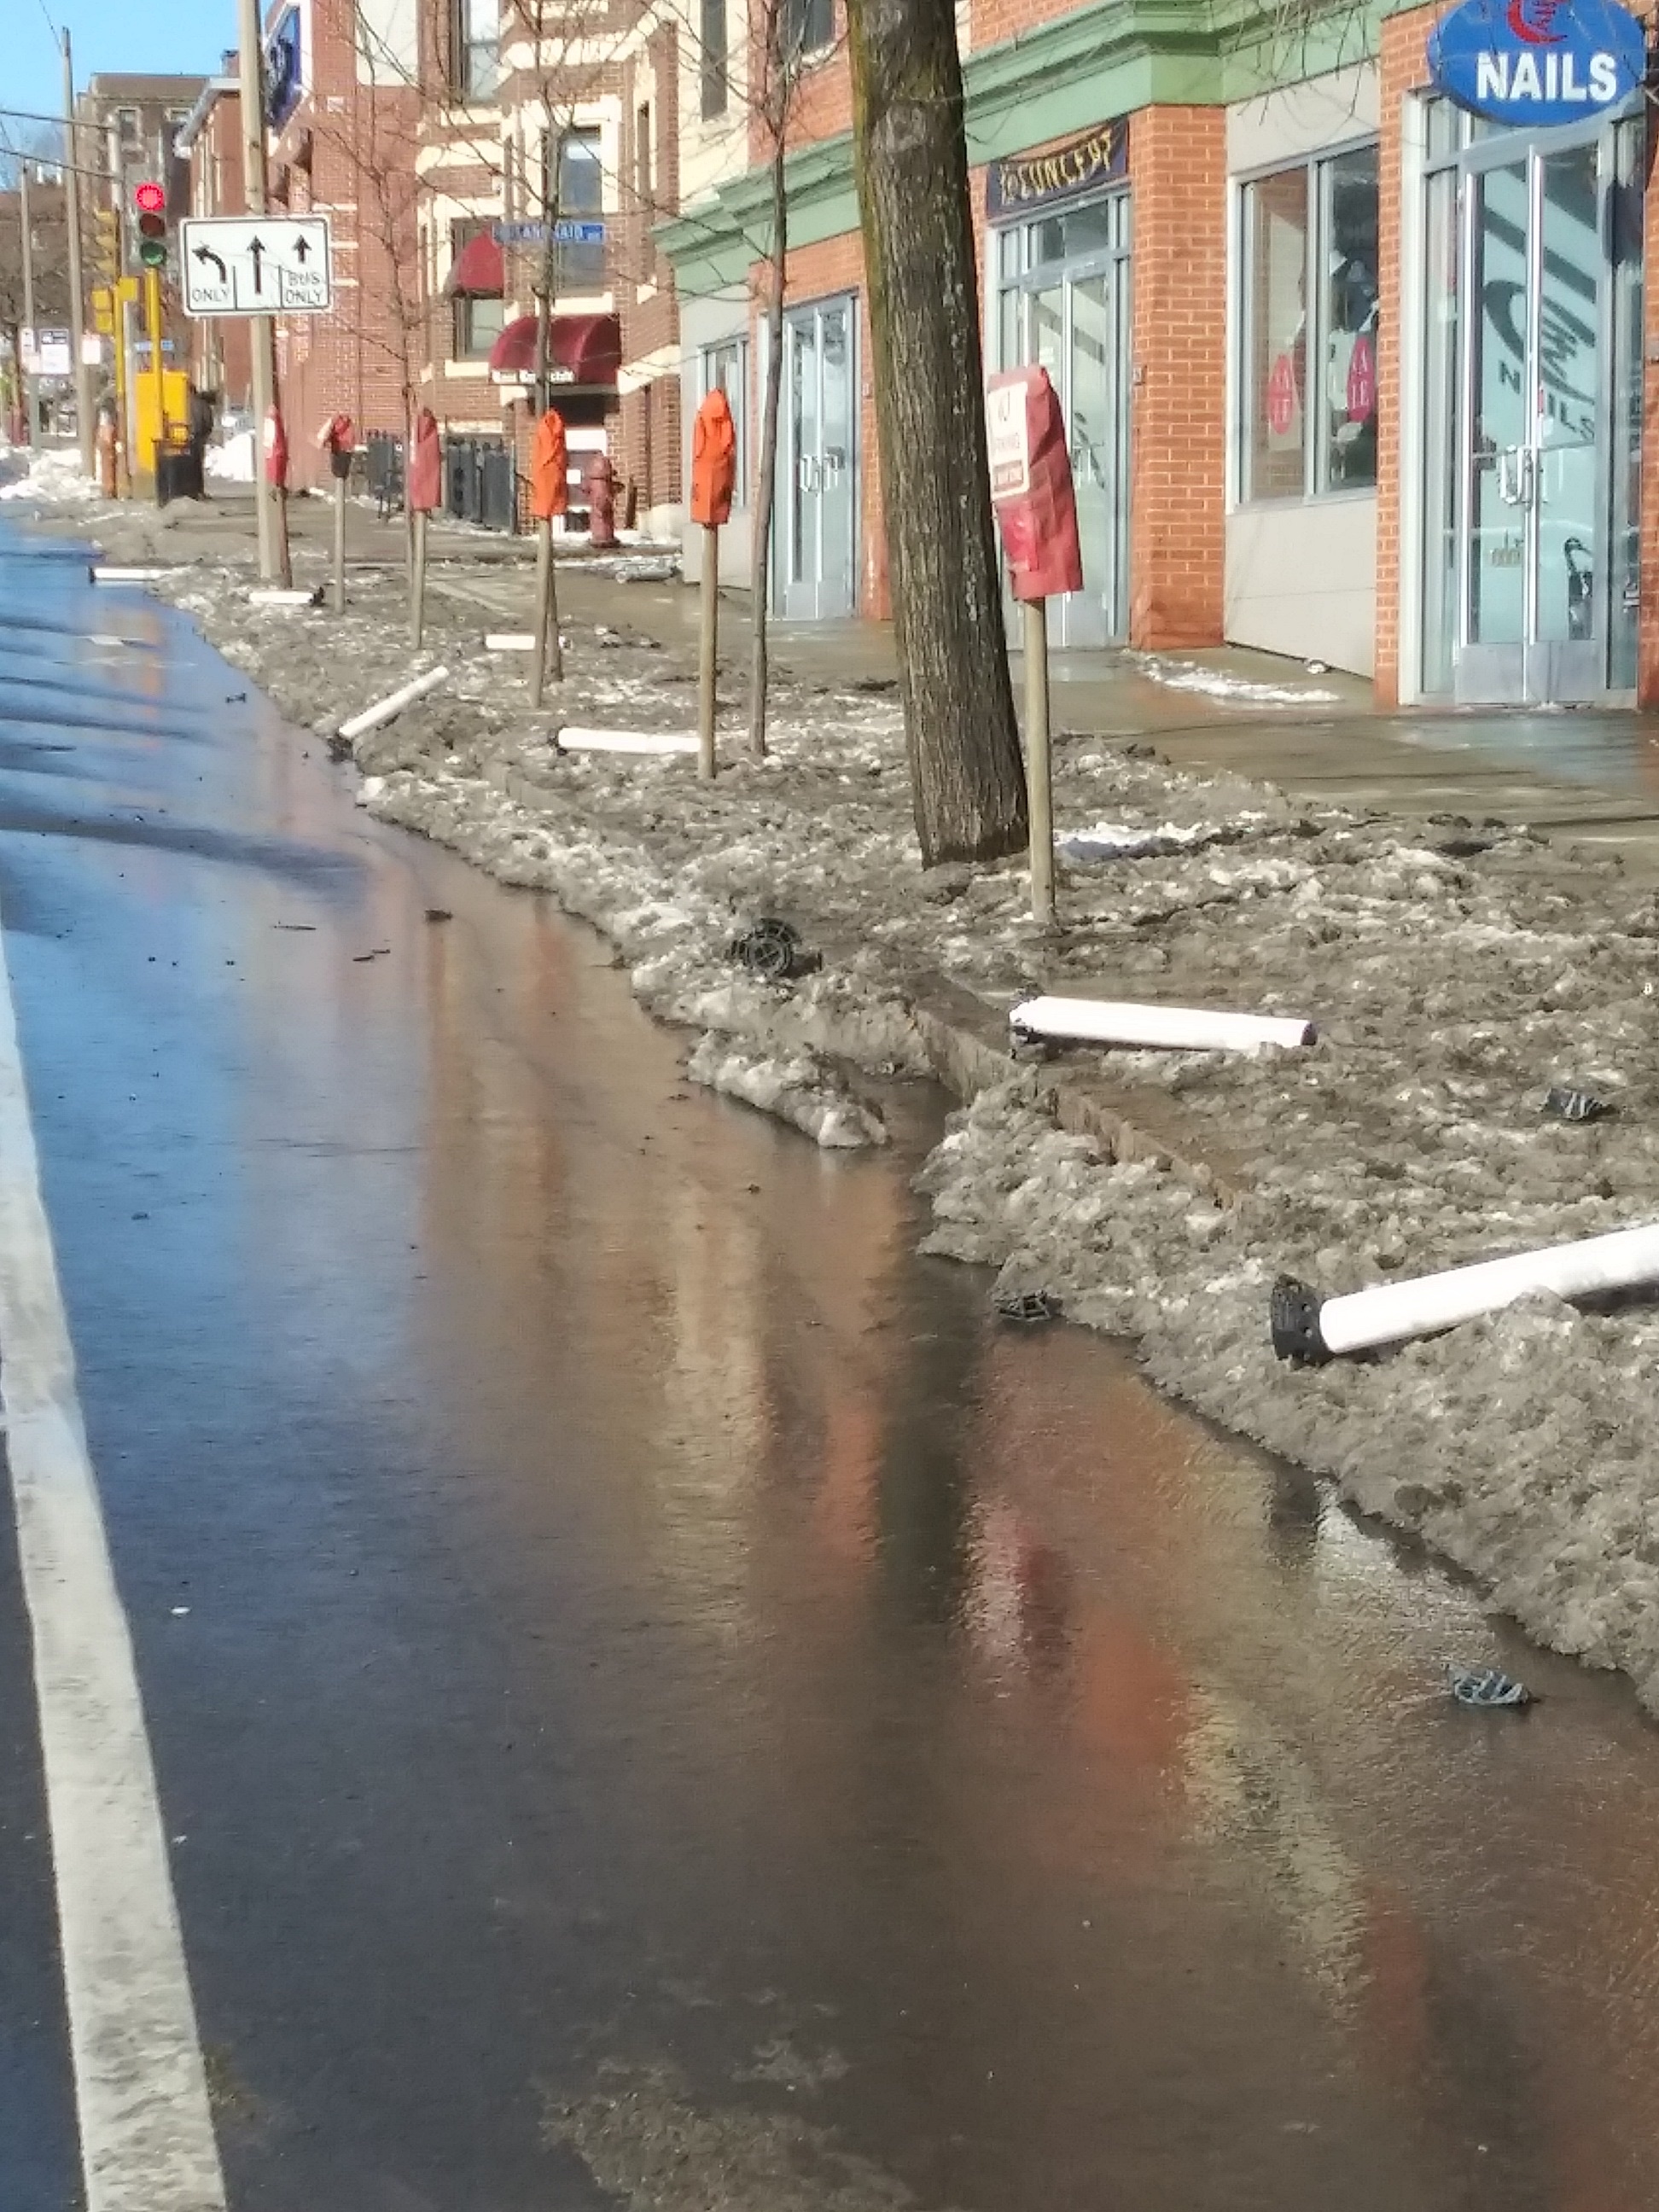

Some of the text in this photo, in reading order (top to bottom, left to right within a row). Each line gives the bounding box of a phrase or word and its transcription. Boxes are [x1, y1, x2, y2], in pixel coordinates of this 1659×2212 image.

[1477, 51, 1617, 102] NAILS
[288, 271, 321, 287] BUS
[192, 288, 230, 302] ONLY
[286, 289, 323, 304] ONLY
